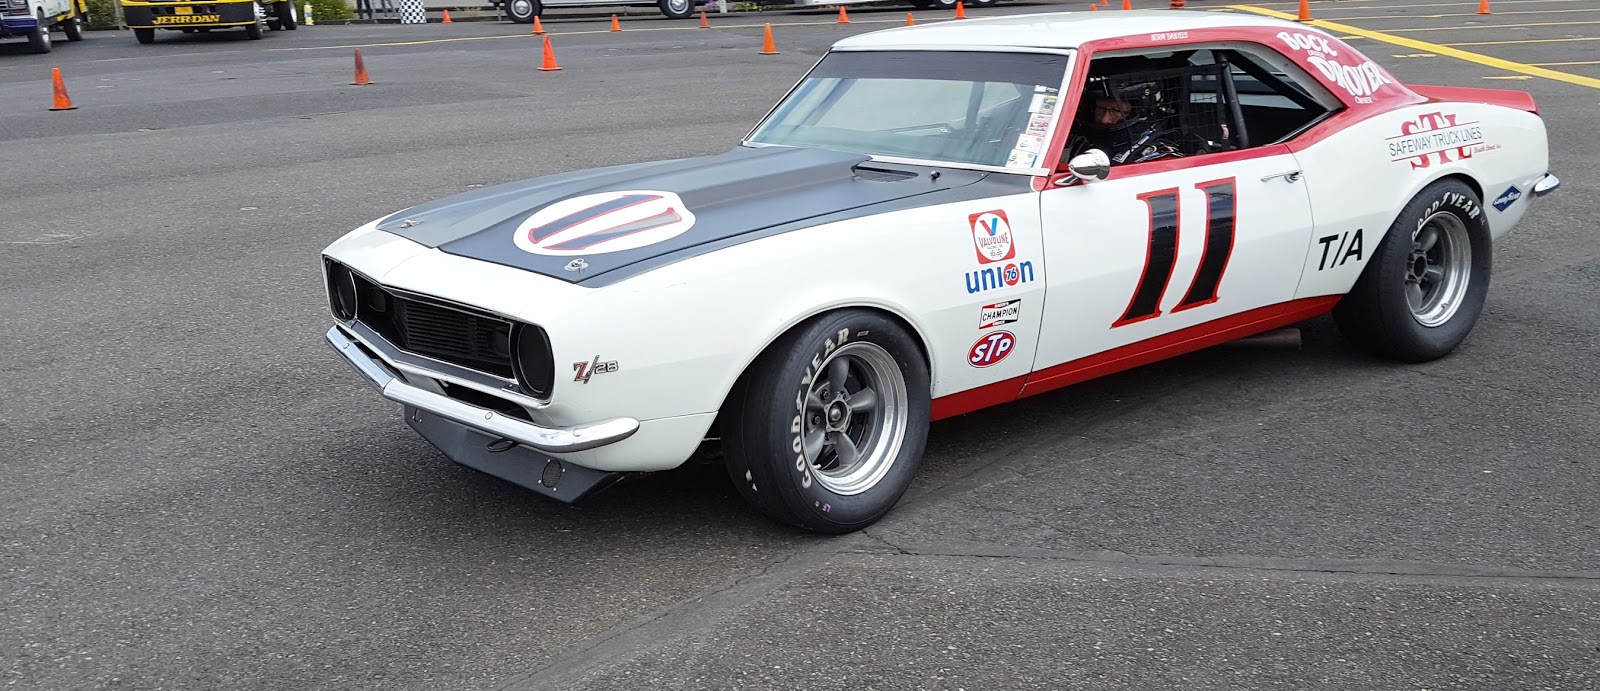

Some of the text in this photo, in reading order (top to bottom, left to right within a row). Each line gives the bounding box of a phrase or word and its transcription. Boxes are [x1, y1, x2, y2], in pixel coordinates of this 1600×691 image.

[1276, 31, 1338, 57] BOCK
[1307, 56, 1392, 97] DROVER
[1388, 126, 1483, 157] SAFEWAY TRUCK LINES
[528, 194, 682, 251] 11
[978, 232, 1010, 249] VALVOLINE
[1109, 175, 1237, 330] 11
[1318, 228, 1363, 272] T/A
[982, 306, 1018, 322] CHAMPION
[971, 333, 1012, 363] STP
[573, 354, 619, 384] Z/28
